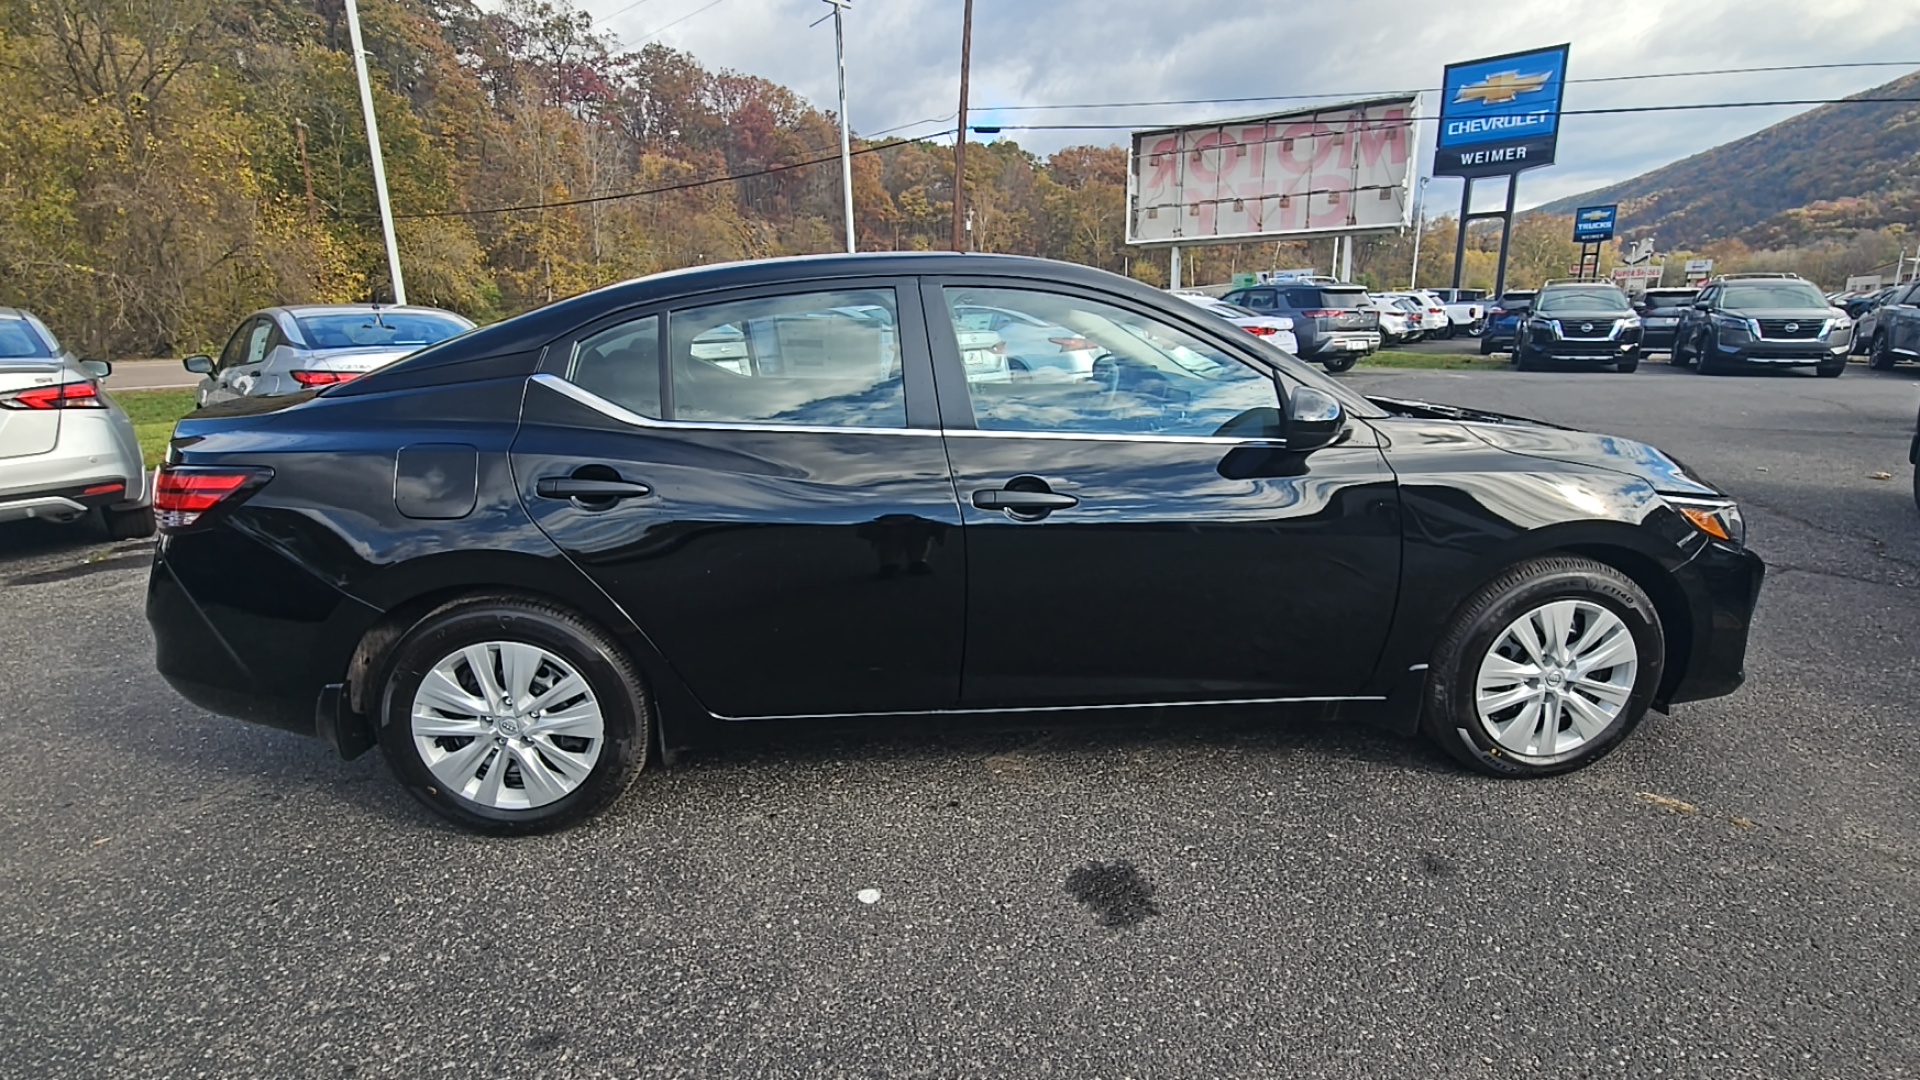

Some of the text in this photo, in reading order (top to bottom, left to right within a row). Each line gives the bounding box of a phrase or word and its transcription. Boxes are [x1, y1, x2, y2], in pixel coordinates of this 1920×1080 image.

[1448, 109, 1549, 135] CHEVROLET
[1461, 146, 1527, 165] WEIMER
[1577, 221, 1612, 231] TRUCKS
